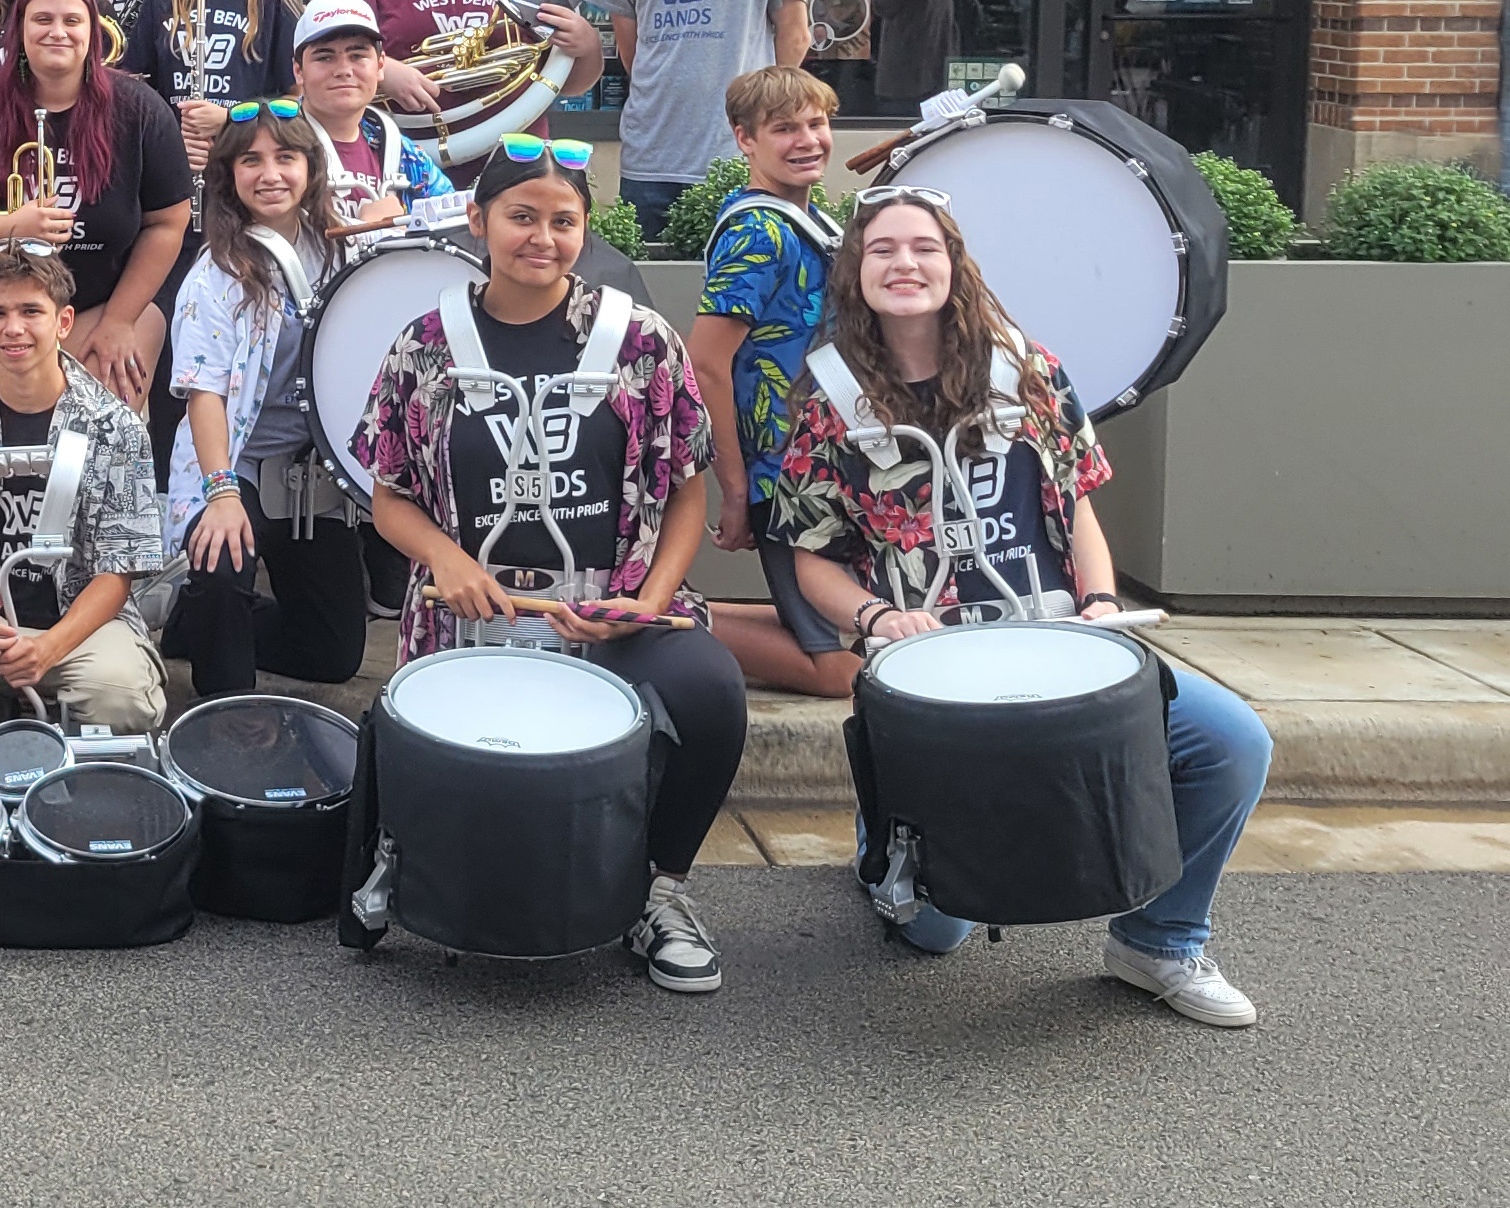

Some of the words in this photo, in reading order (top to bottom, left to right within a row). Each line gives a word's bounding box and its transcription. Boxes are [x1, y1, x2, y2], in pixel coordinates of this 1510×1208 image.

[654, 8, 712, 29] BANDS
[74, 243, 105, 251] PRIDE
[577, 499, 610, 517] PRIDE
[4, 770, 45, 783] EVANS
[264, 790, 306, 798] EVANS
[89, 843, 132, 852] EVANS
